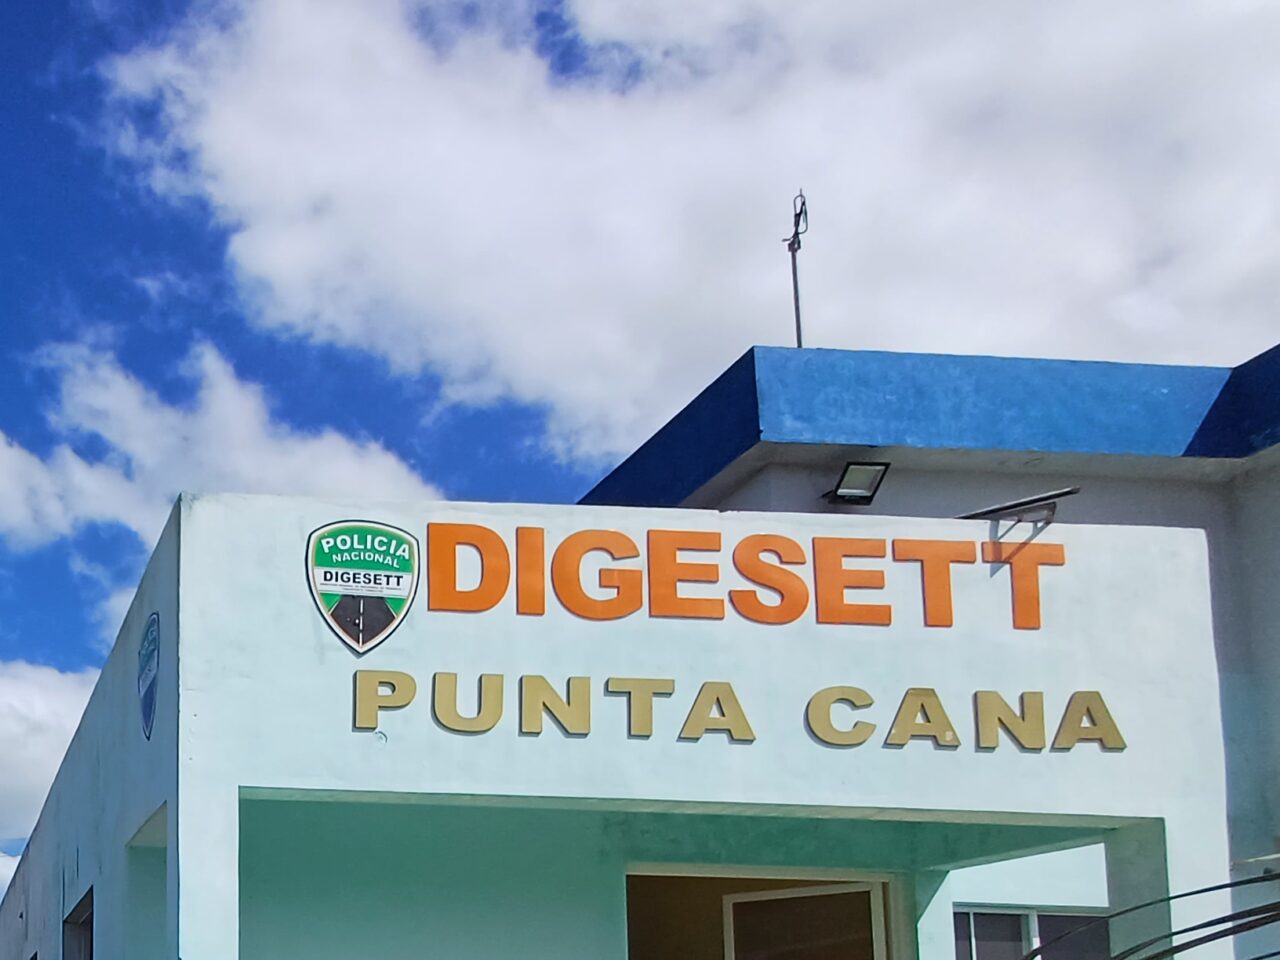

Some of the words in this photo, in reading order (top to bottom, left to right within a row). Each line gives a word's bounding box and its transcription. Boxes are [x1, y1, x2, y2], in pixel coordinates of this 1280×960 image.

[321, 534, 410, 560] POLICIA
[332, 551, 400, 569] NACIONAL
[323, 570, 404, 587] DIGESETT
[428, 522, 1065, 630] DIGESETT
[353, 670, 756, 742] PUNTA
[805, 686, 1127, 750] CANA
